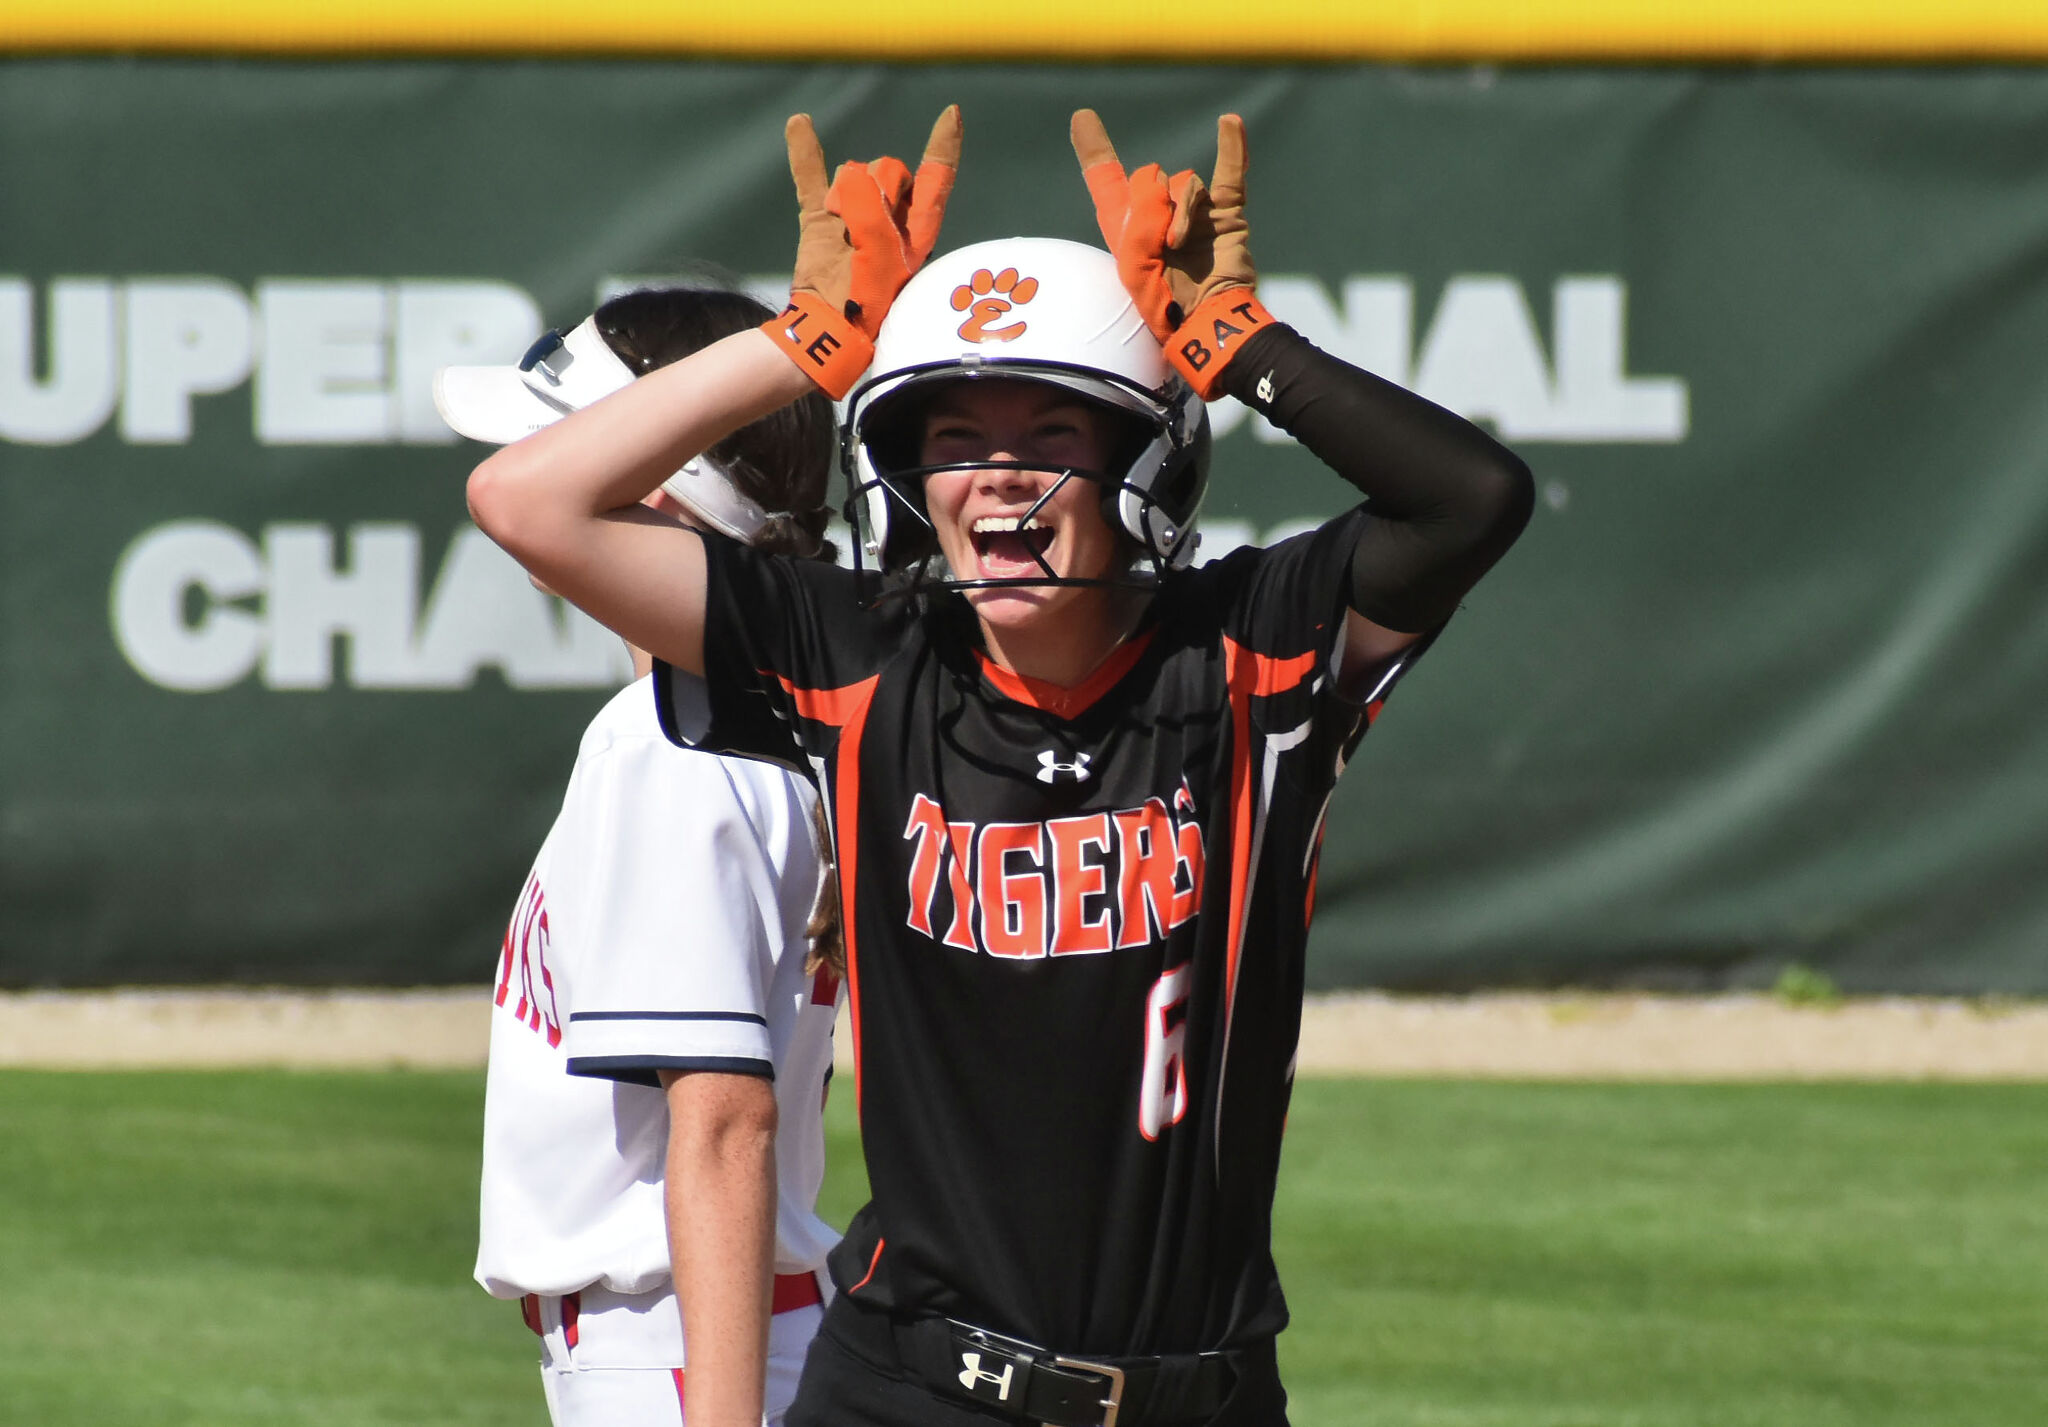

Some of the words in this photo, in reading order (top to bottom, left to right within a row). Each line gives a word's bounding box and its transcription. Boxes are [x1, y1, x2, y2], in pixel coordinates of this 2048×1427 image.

[1180, 302, 1259, 372] BAT
[112, 519, 636, 692] CHA
[903, 774, 1206, 960] TIGERS
[1138, 960, 1191, 1142] 6
